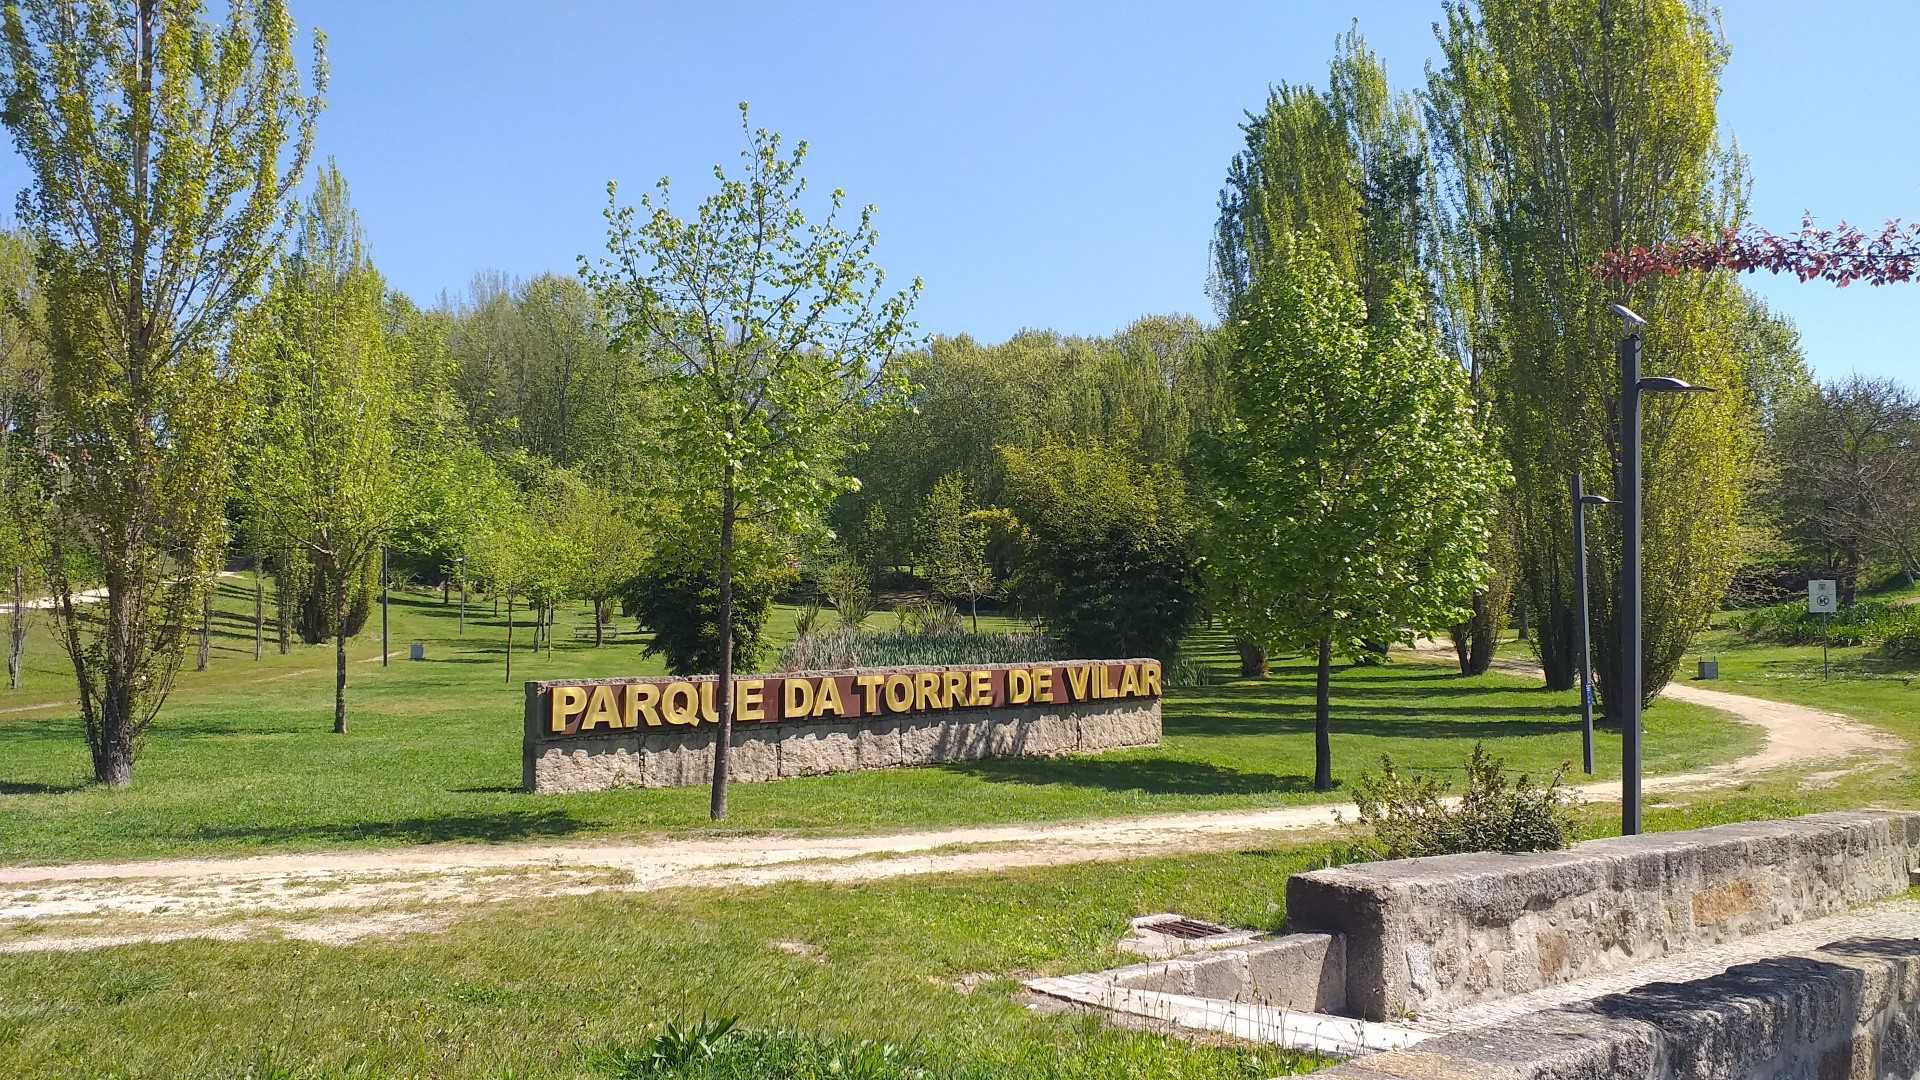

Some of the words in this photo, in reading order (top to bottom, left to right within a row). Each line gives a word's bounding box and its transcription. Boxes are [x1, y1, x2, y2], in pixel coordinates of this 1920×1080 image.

[551, 680, 765, 732] PARQUE
[784, 677, 845, 718] DA
[857, 671, 993, 714] TORRE
[1008, 667, 1054, 703] DE
[1065, 663, 1162, 700] VILAR
